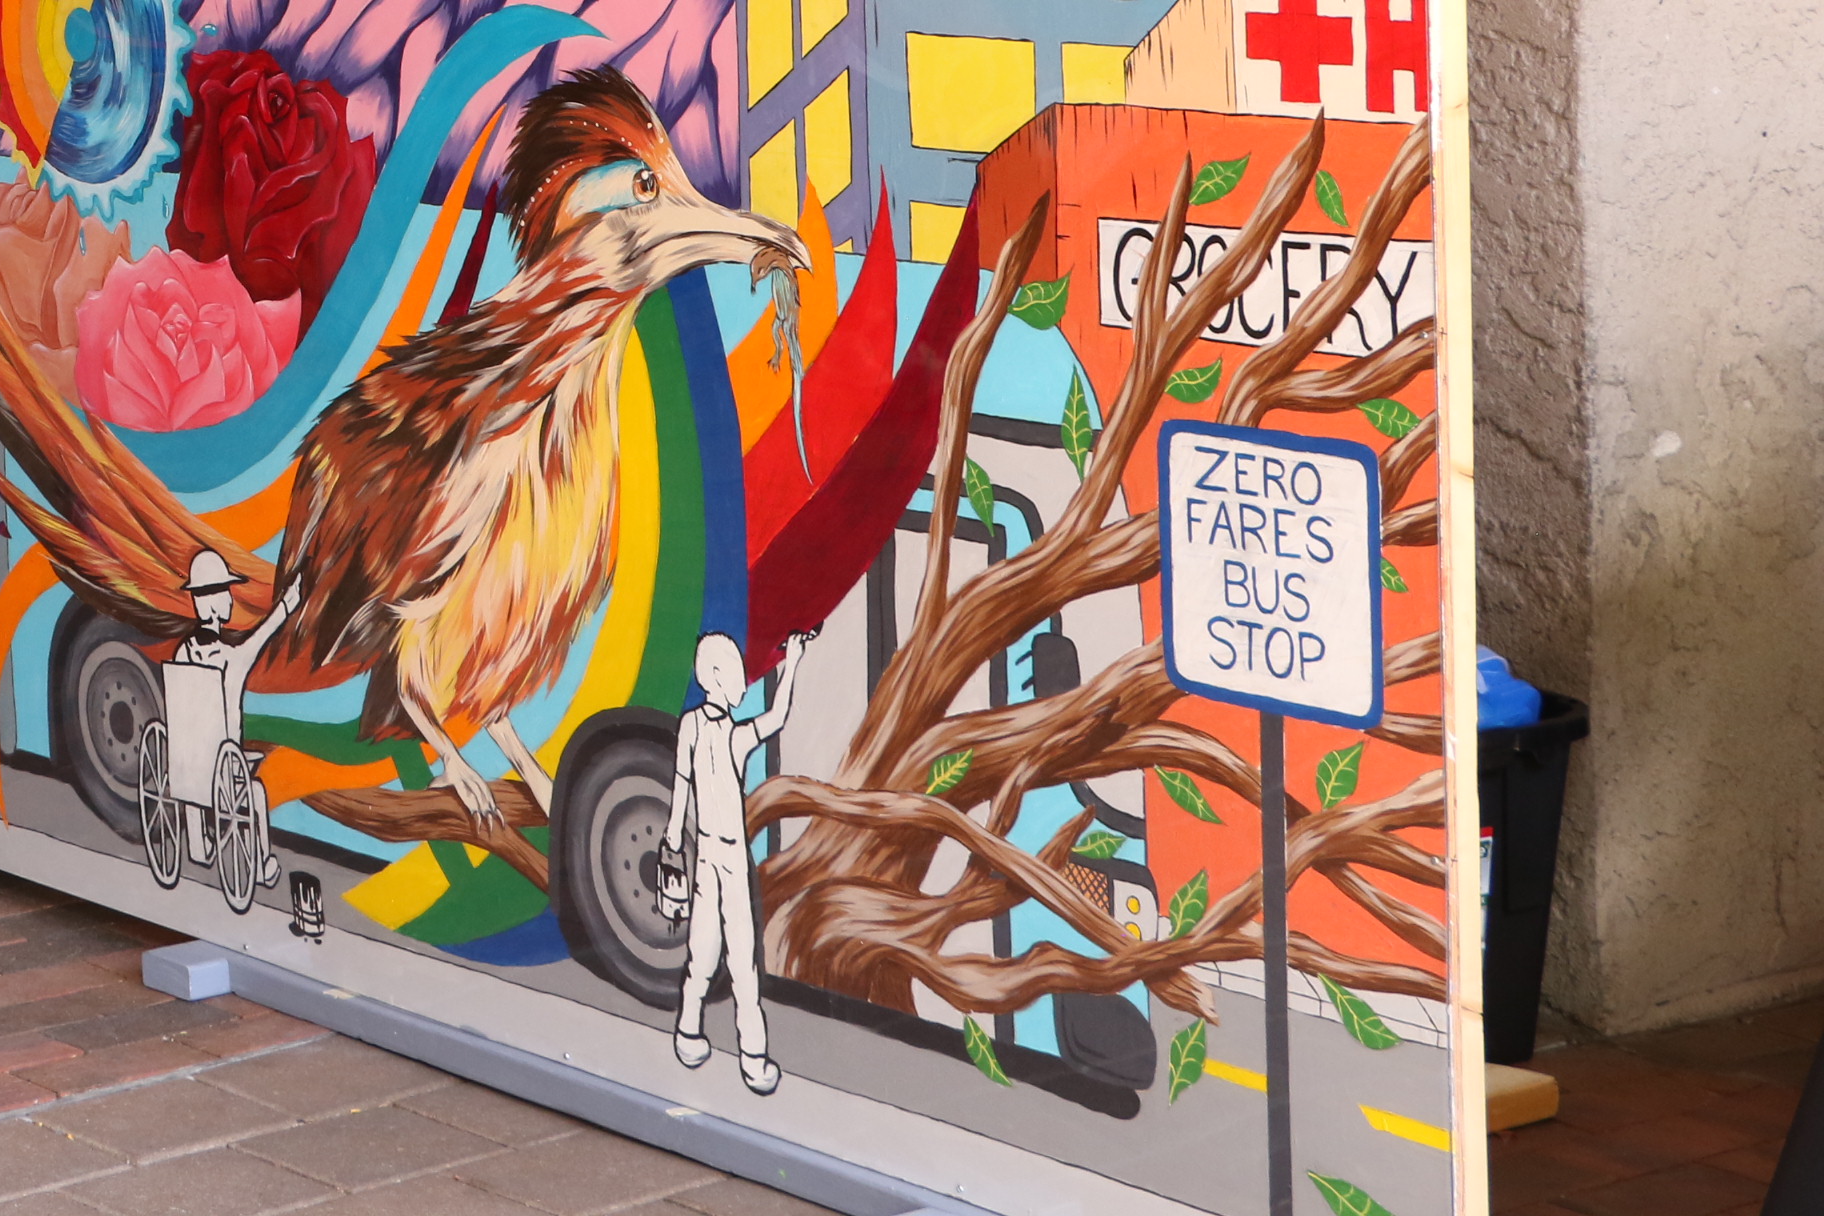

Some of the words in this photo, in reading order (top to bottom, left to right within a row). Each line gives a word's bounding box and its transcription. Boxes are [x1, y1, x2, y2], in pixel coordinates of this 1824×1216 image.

[1194, 445, 1322, 505] ZERO
[1186, 497, 1335, 563] FARES
[1223, 560, 1310, 623] BUS
[1207, 616, 1326, 681] STOP
